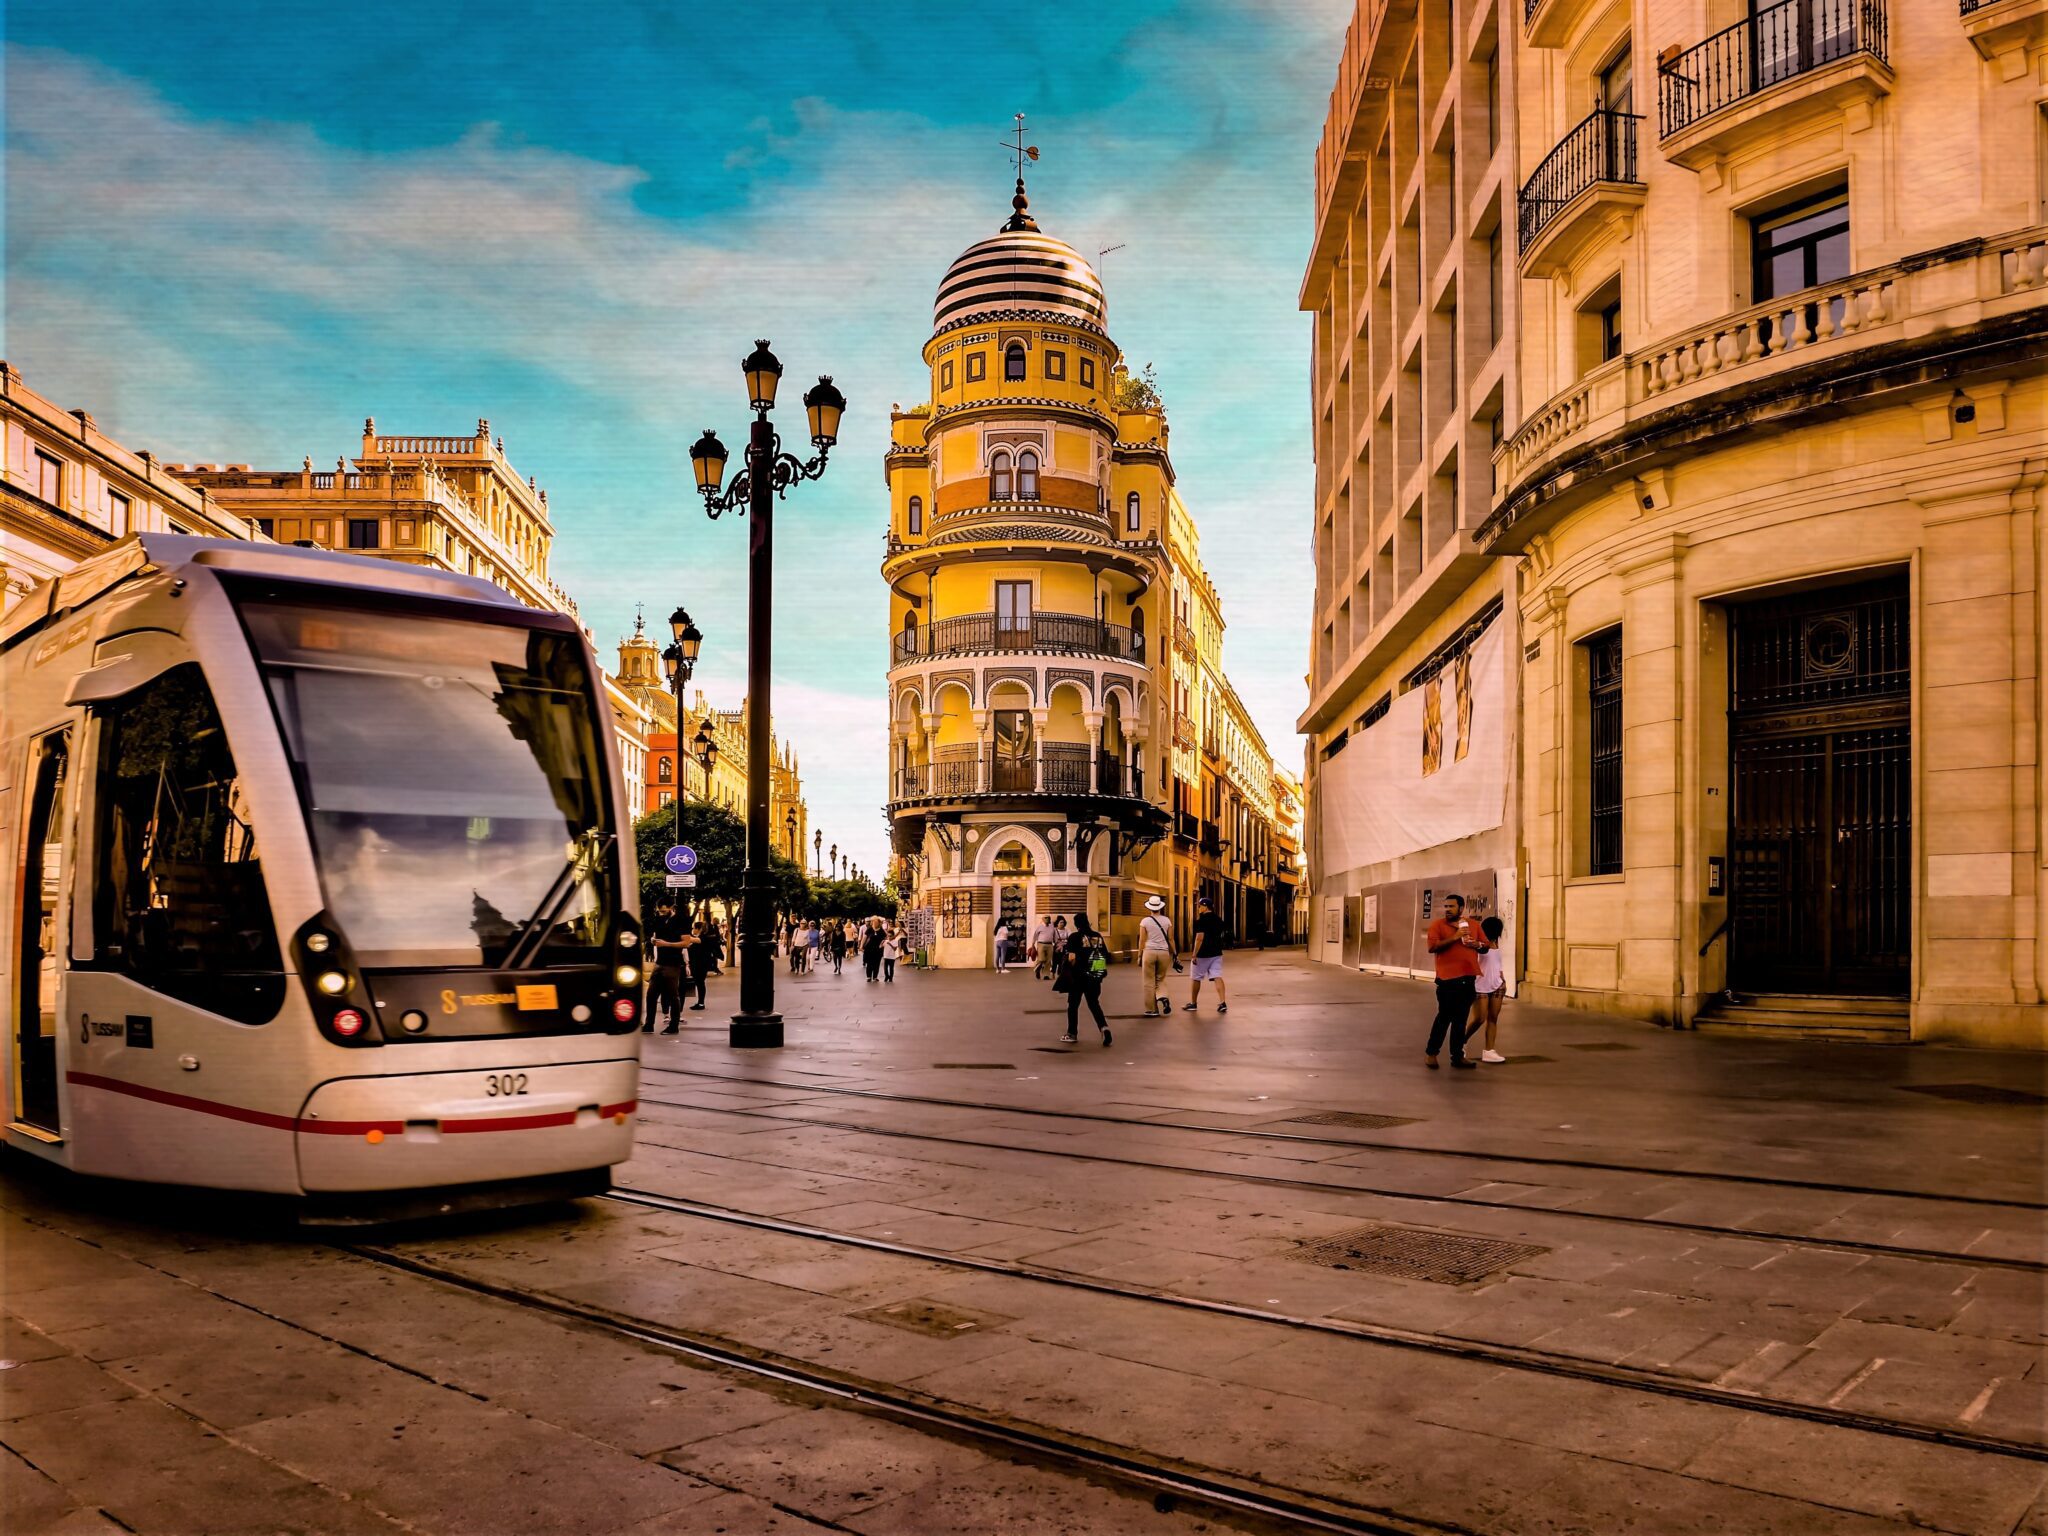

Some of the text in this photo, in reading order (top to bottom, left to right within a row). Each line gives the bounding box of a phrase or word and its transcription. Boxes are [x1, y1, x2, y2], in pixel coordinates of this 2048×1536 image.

[458, 993, 517, 1006] TUSSAM
[91, 1022, 124, 1037] TUSSAM
[486, 1073, 528, 1097] 302
